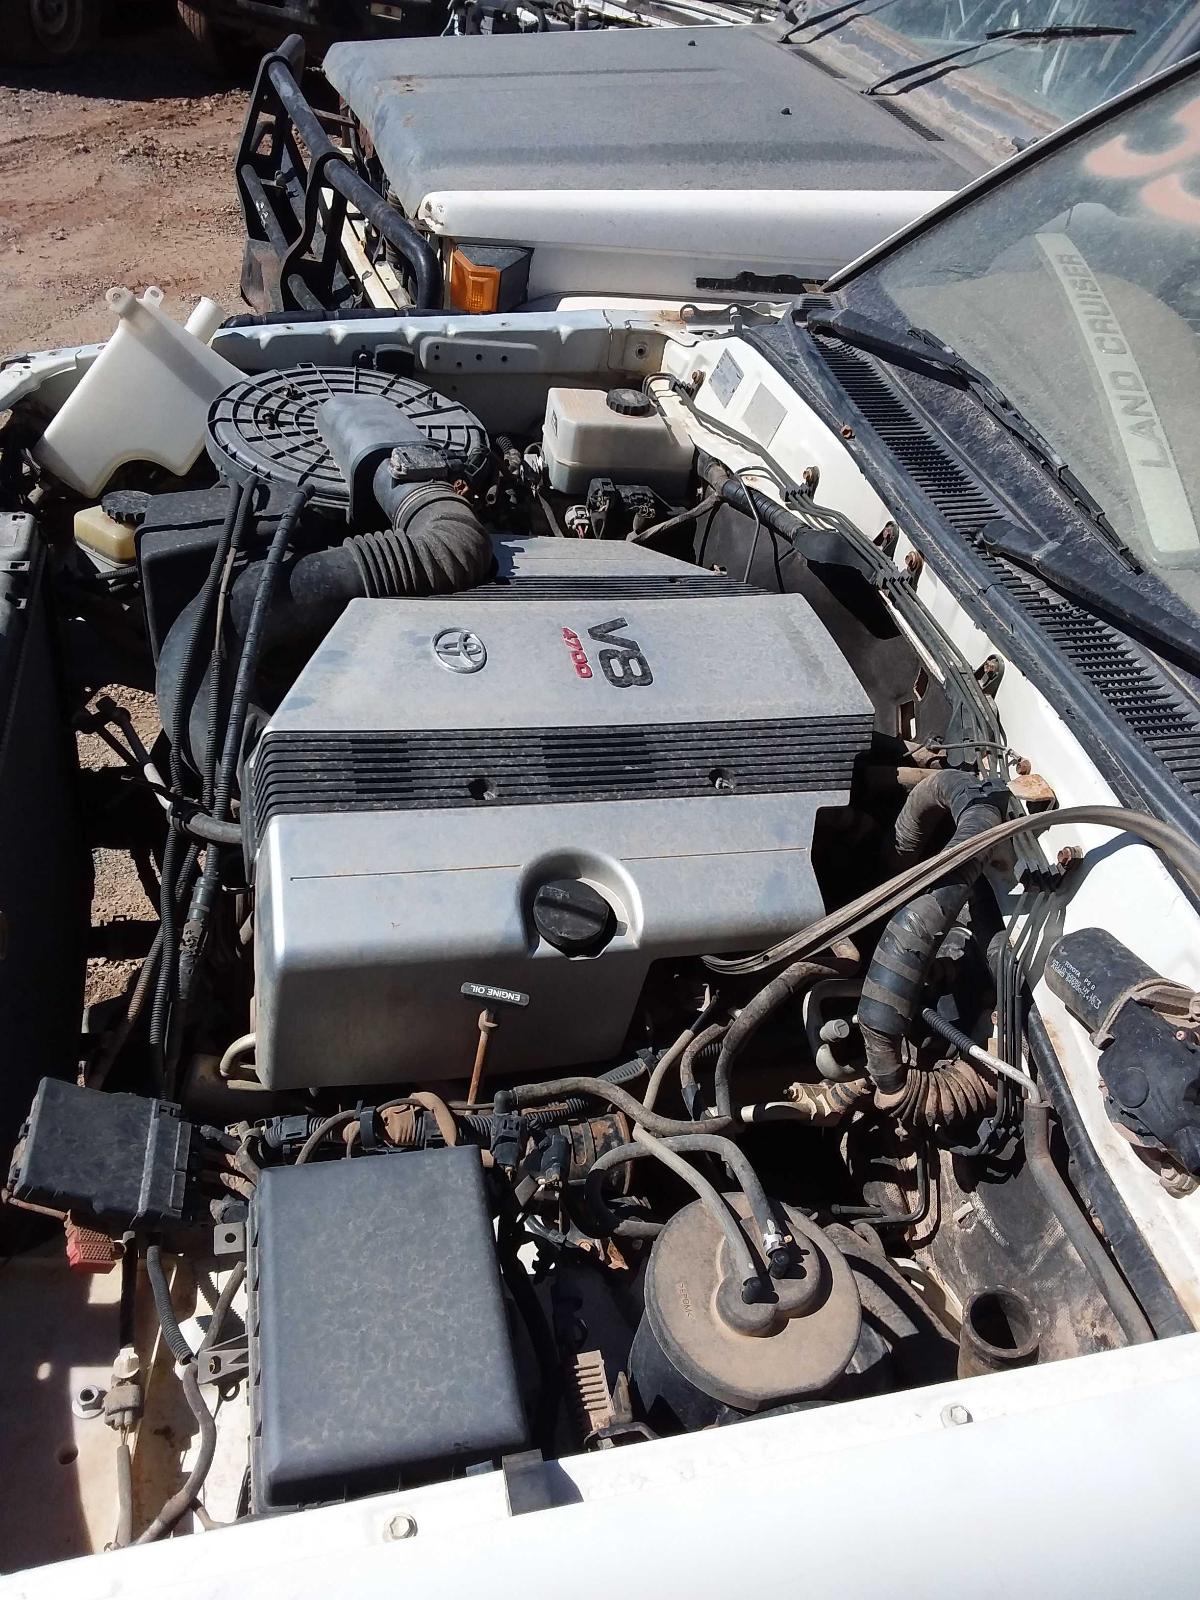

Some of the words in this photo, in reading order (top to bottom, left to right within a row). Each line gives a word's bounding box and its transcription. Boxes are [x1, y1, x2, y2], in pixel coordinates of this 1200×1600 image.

[1057, 254, 1128, 355] CRUISER
[1108, 371, 1172, 469] LAND
[561, 626, 593, 679] 4700
[588, 616, 654, 689] V8
[470, 984, 486, 994] OIL
[487, 988, 521, 1002] ENGINE
[1064, 960, 1081, 978] TOYOTA
